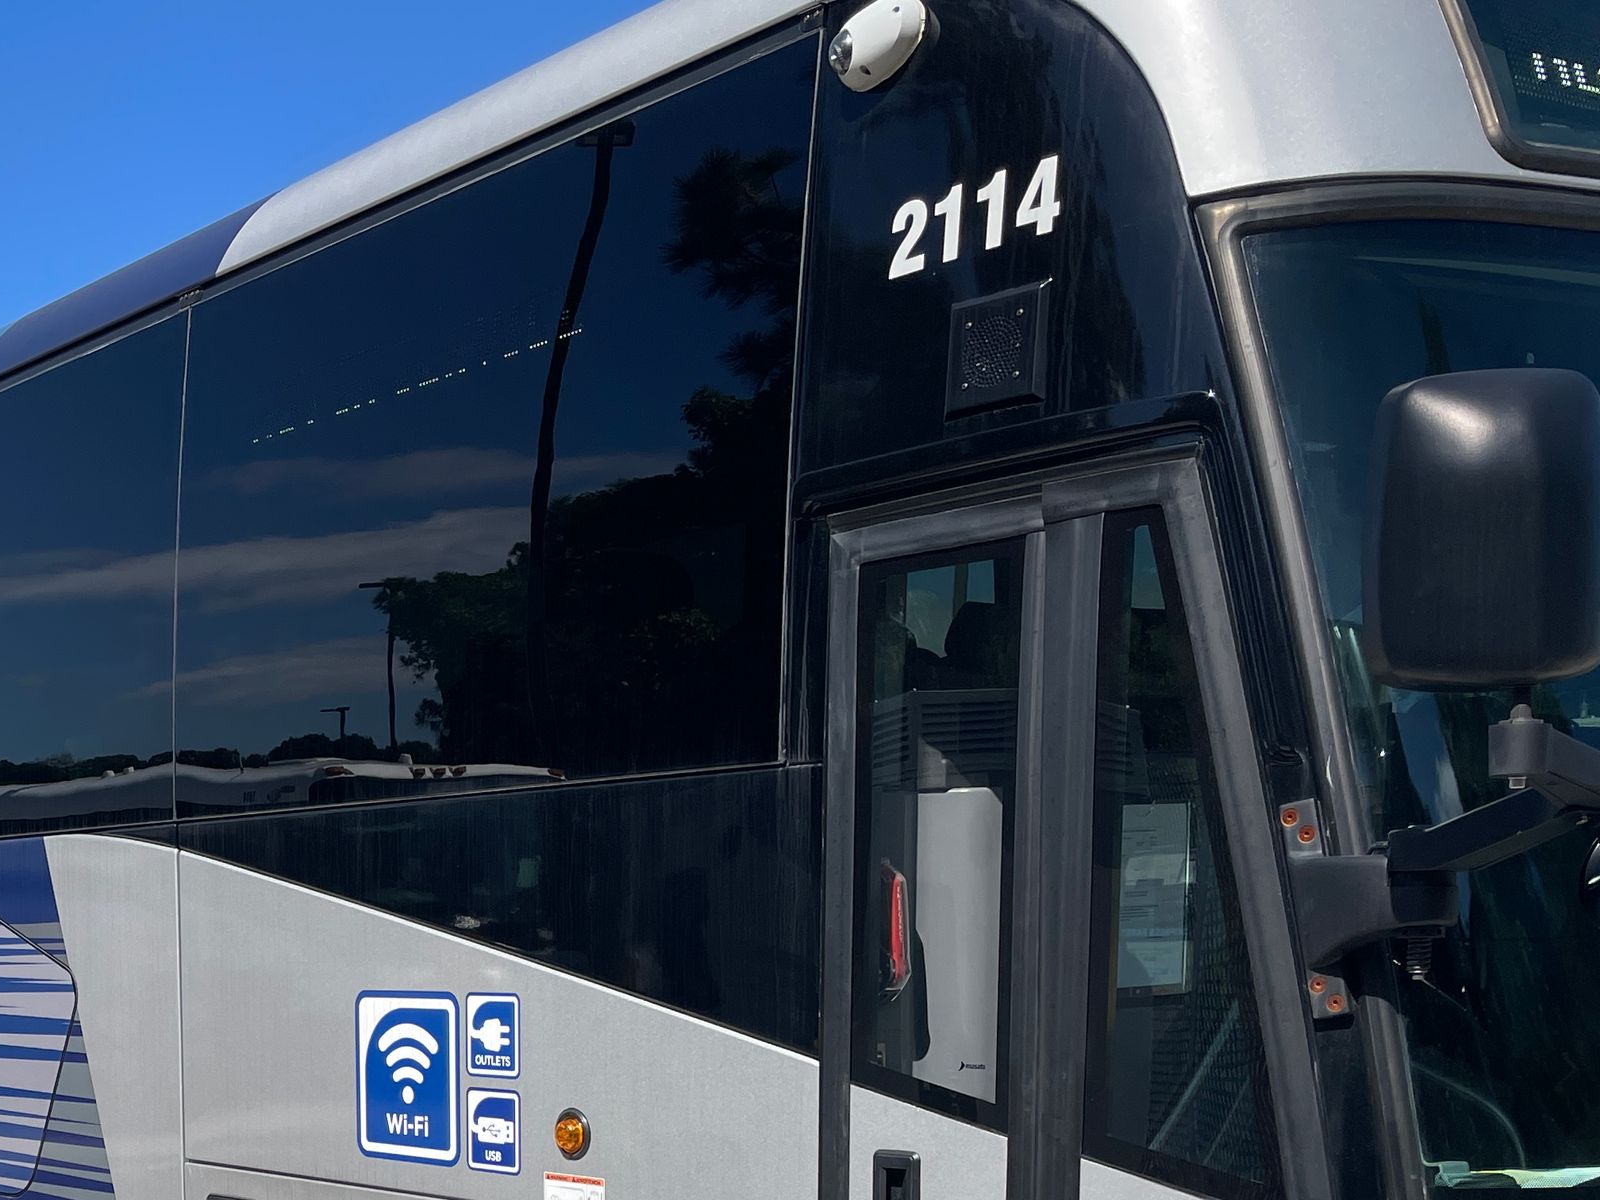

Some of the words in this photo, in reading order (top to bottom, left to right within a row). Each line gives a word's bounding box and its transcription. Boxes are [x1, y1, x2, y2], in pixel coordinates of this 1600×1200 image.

[888, 155, 1060, 280] 2114
[474, 1054, 511, 1067] OUTLETS
[386, 1112, 429, 1138] Wi-Fi
[484, 1150, 502, 1162] USB
